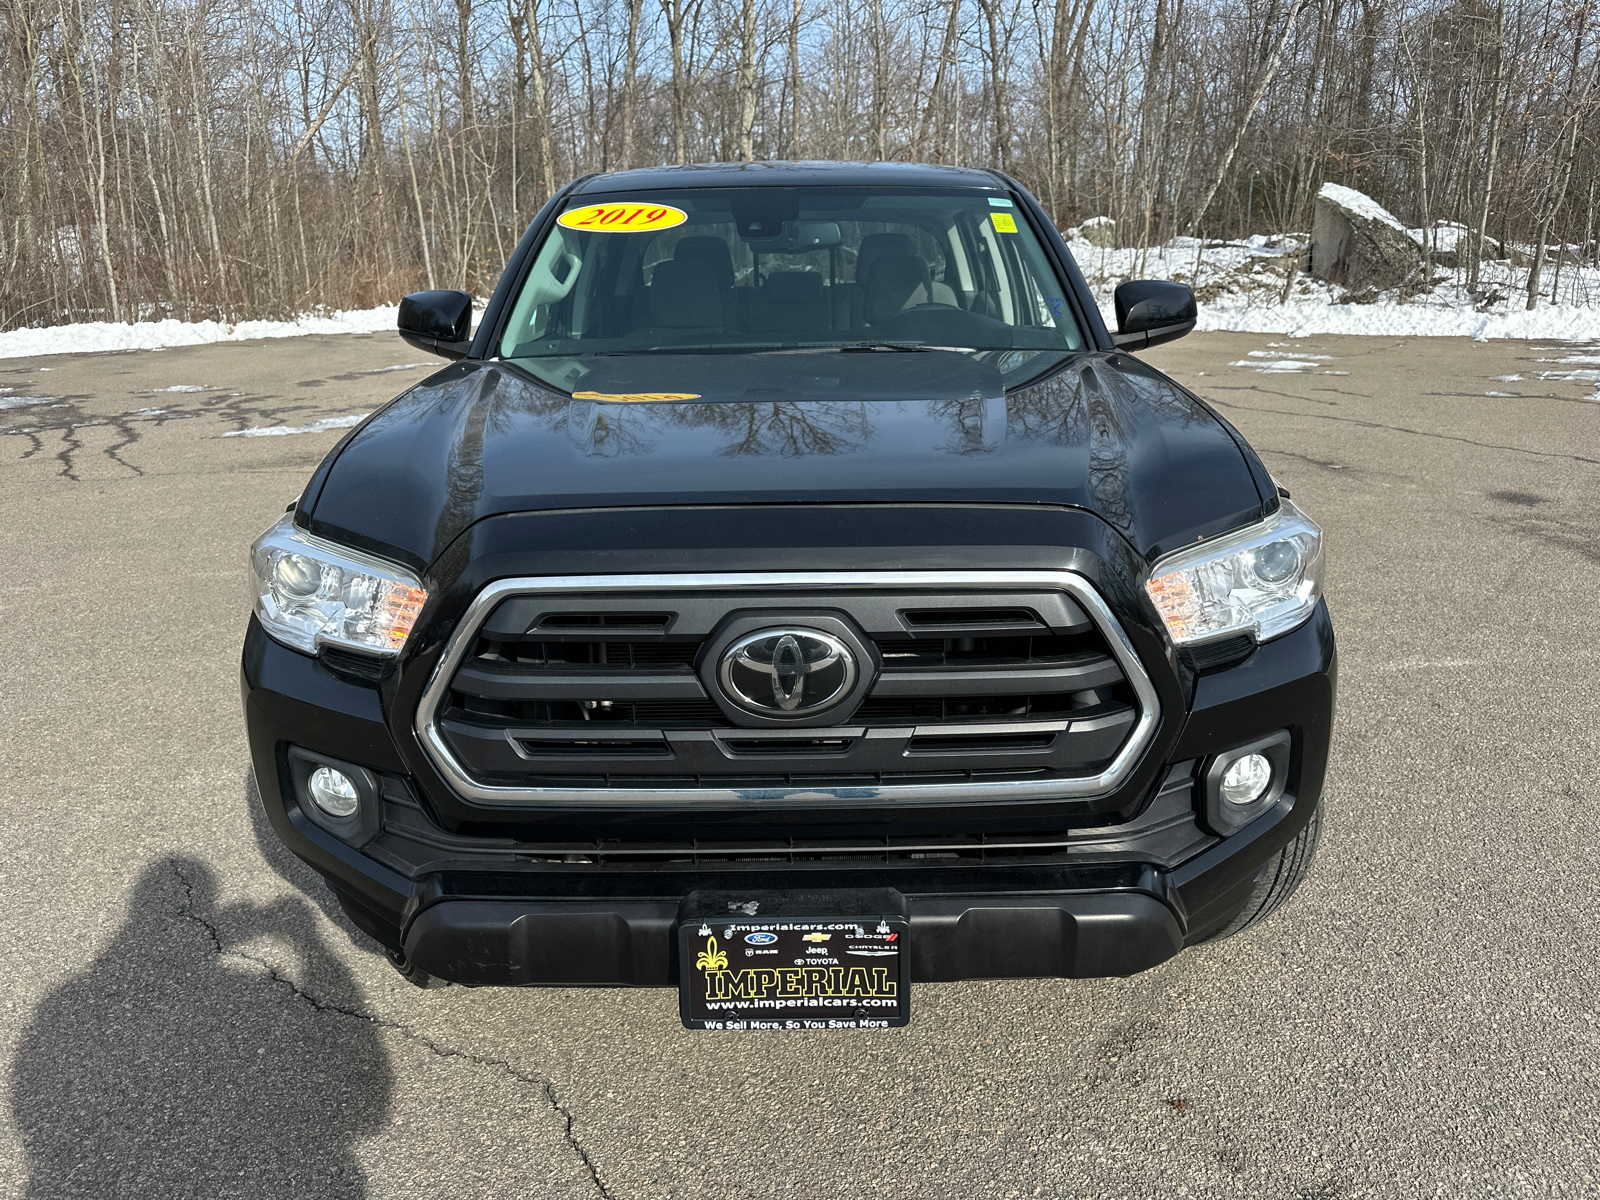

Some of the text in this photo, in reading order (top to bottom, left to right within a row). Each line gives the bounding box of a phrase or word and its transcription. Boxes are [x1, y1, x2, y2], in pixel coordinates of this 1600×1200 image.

[577, 209, 667, 225] 2019
[730, 923, 858, 931] Imperialcars.com
[752, 934, 771, 943] Ford
[705, 967, 897, 1000] IMPERIAL
[706, 997, 898, 1010] www.imperialcars.com
[704, 1020, 889, 1030] We Sell More, So You Save More
